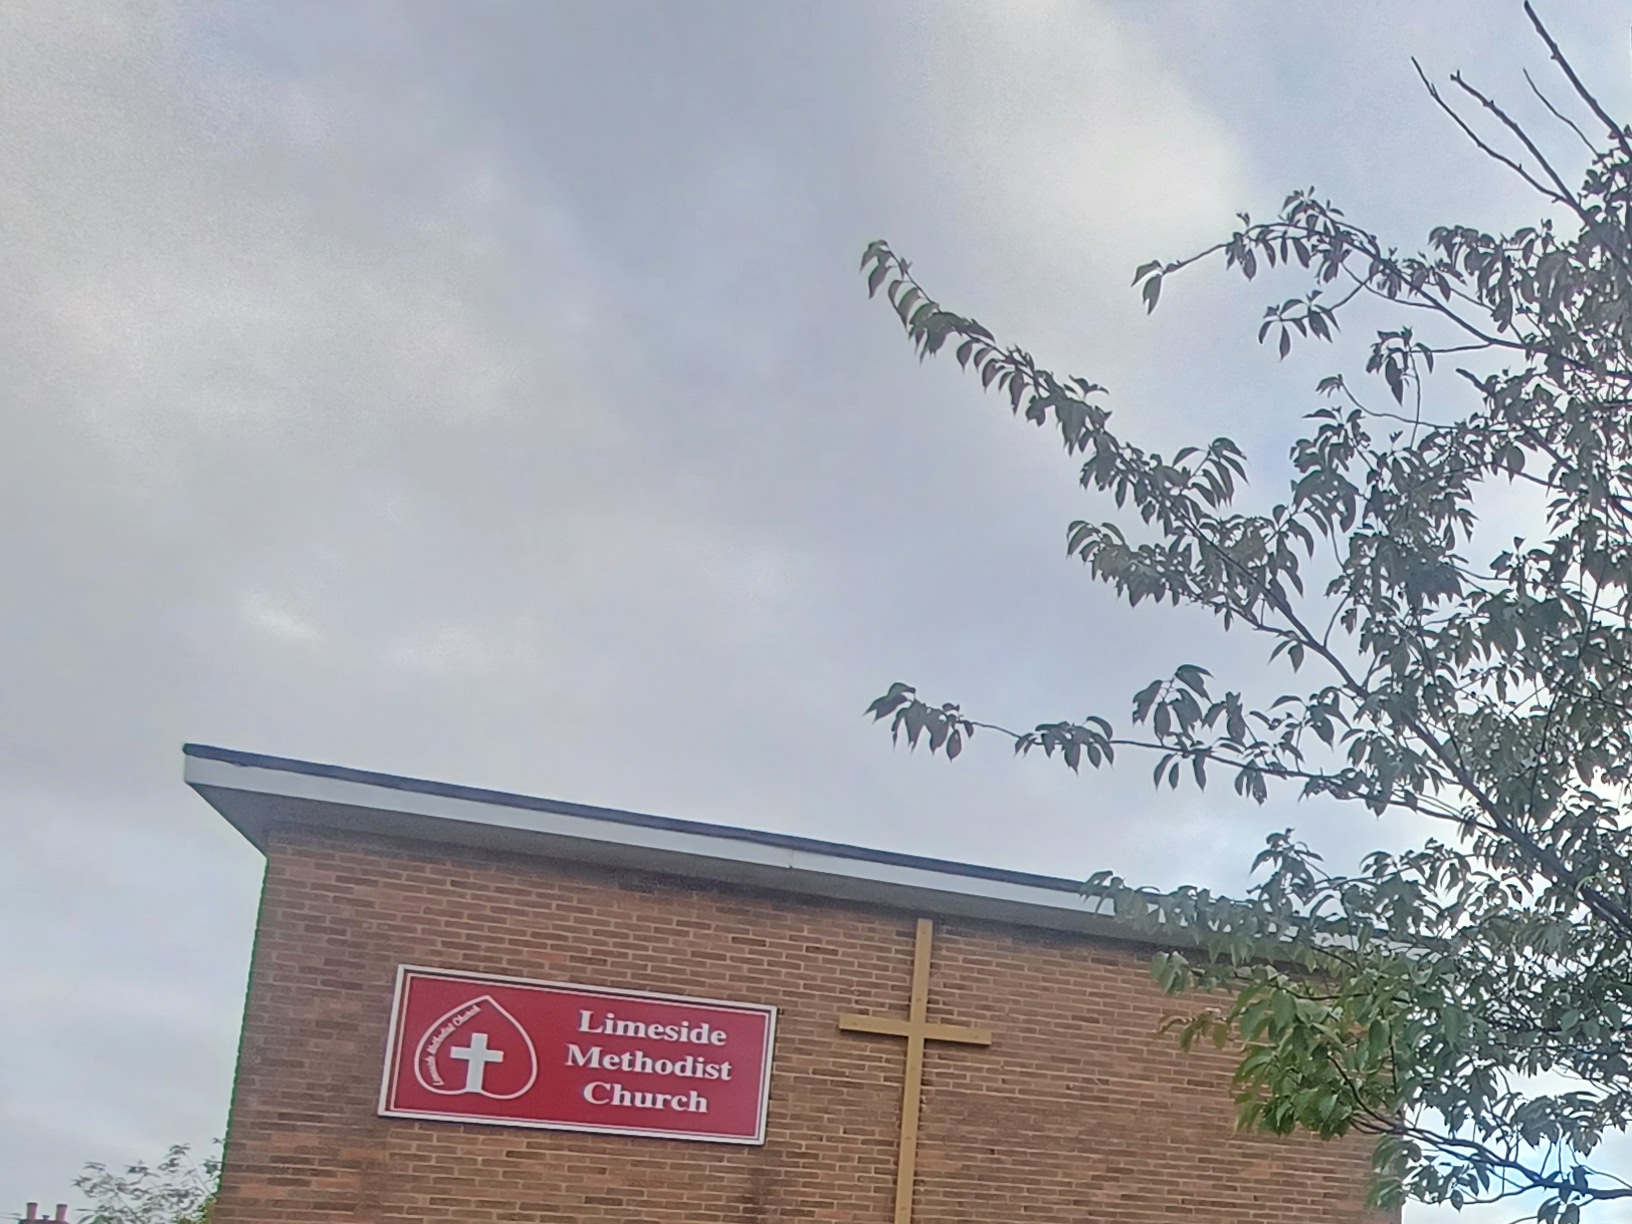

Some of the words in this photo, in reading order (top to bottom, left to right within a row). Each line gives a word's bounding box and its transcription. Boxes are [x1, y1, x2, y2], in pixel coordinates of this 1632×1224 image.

[577, 1009, 727, 1046] Limeside
[564, 1043, 732, 1081] Methodist
[583, 1081, 708, 1113] Church
